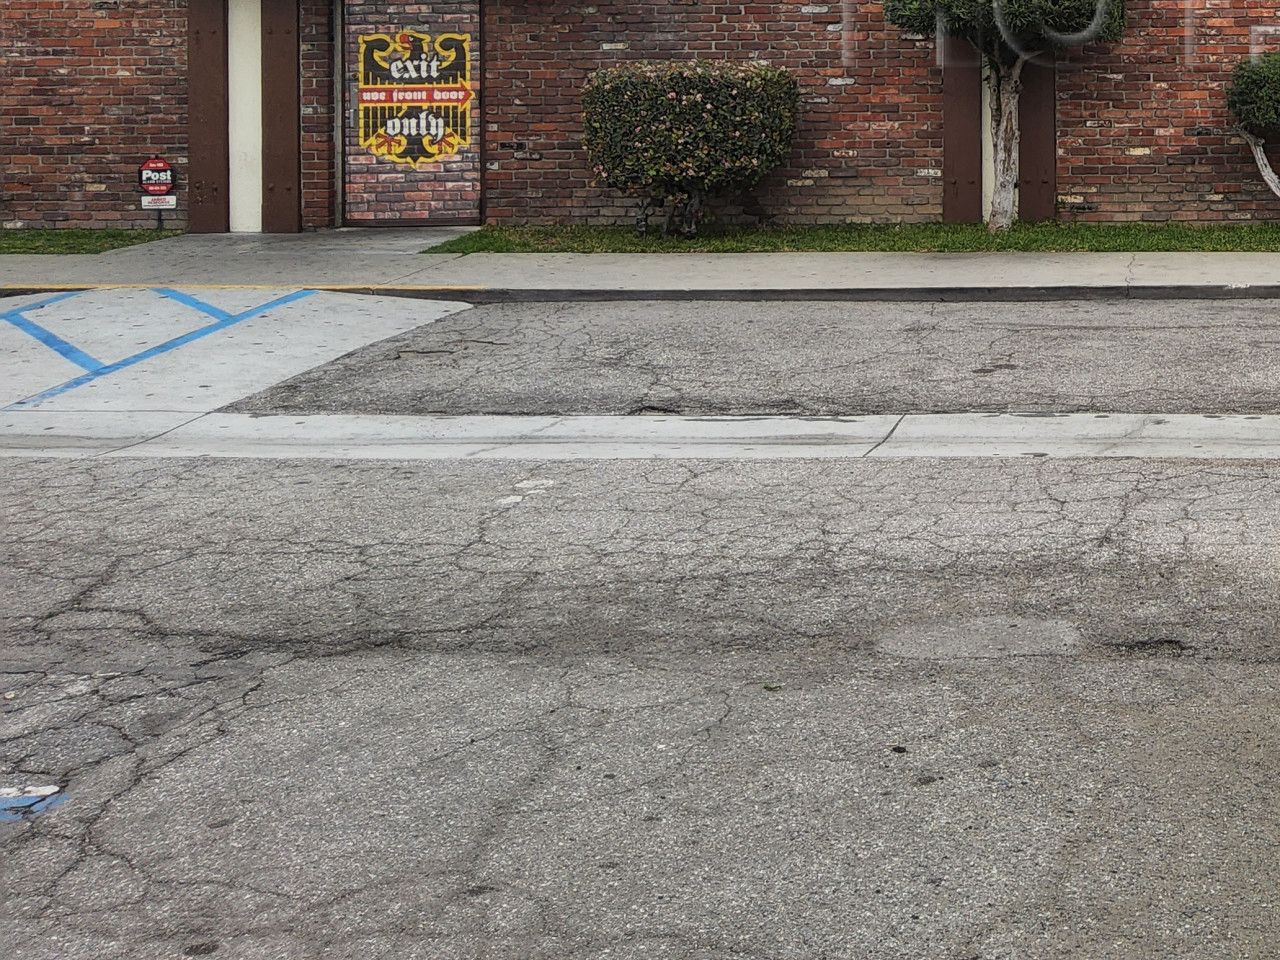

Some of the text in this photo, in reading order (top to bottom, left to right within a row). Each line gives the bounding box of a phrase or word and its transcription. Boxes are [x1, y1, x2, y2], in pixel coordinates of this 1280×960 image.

[390, 53, 440, 78] exit
[433, 88, 465, 101] door
[387, 111, 443, 143] only
[142, 170, 171, 180] Post
